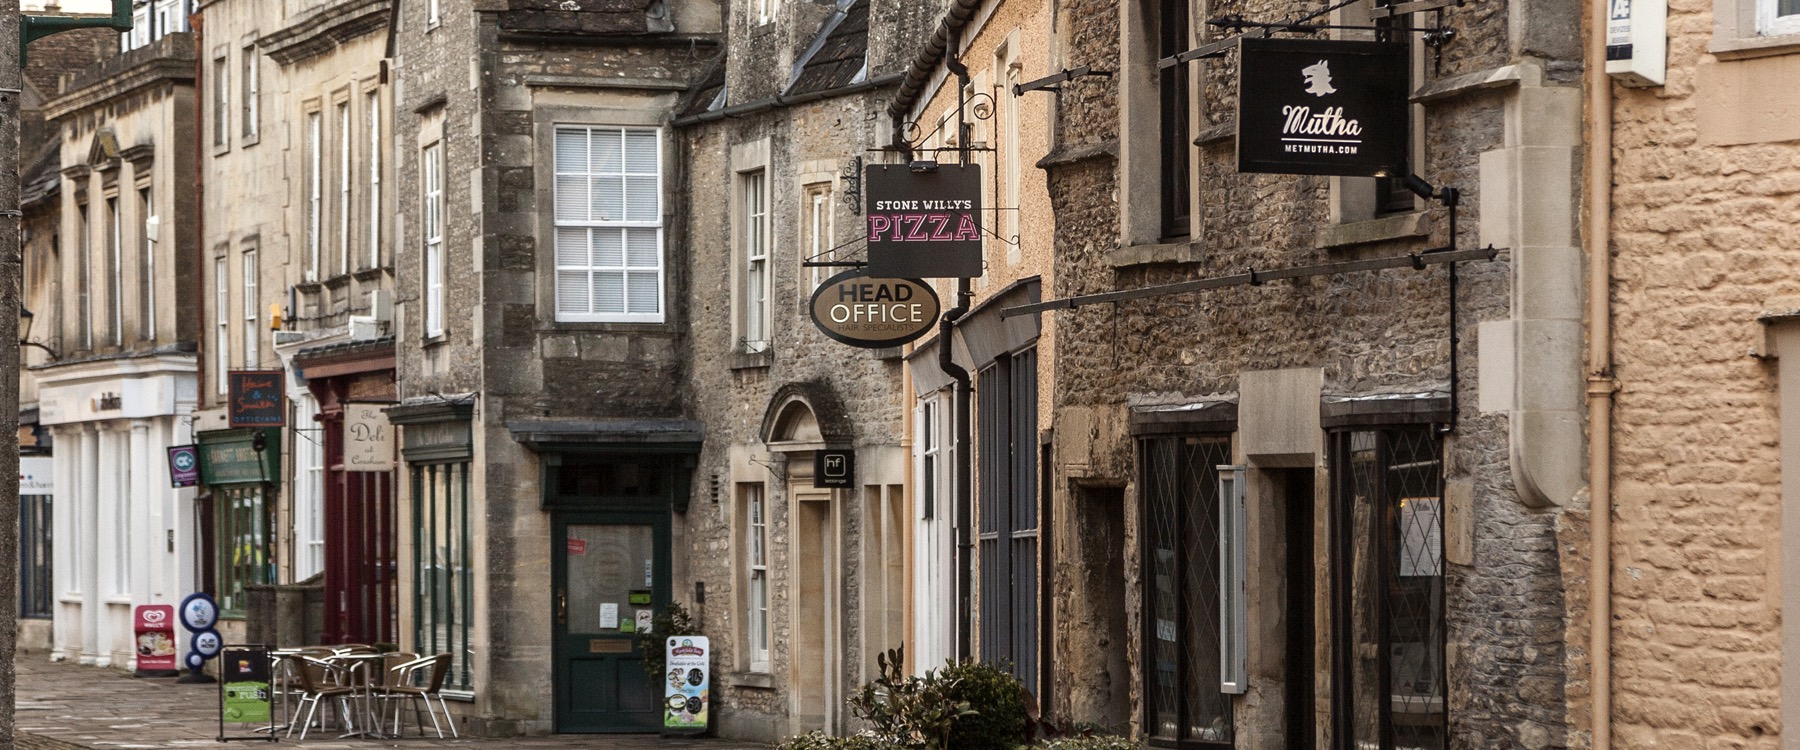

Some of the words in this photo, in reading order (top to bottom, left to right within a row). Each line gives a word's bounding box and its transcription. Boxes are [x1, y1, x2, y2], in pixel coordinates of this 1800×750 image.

[1282, 105, 1362, 136] Mutha
[1284, 144, 1358, 154] METMUTHA.COM
[876, 200, 919, 210] STONE
[923, 200, 972, 210] WILLY'S
[868, 213, 981, 242] PIZZA
[838, 283, 913, 303] HEAD
[830, 303, 923, 323] OFFICE
[838, 324, 859, 332] HAIR
[863, 324, 914, 332] SPECIALISTS
[360, 409, 377, 420] The
[350, 422, 385, 442] Deli
[351, 455, 387, 465] Corsham
[826, 458, 841, 468] hf
[240, 689, 267, 699] rush
